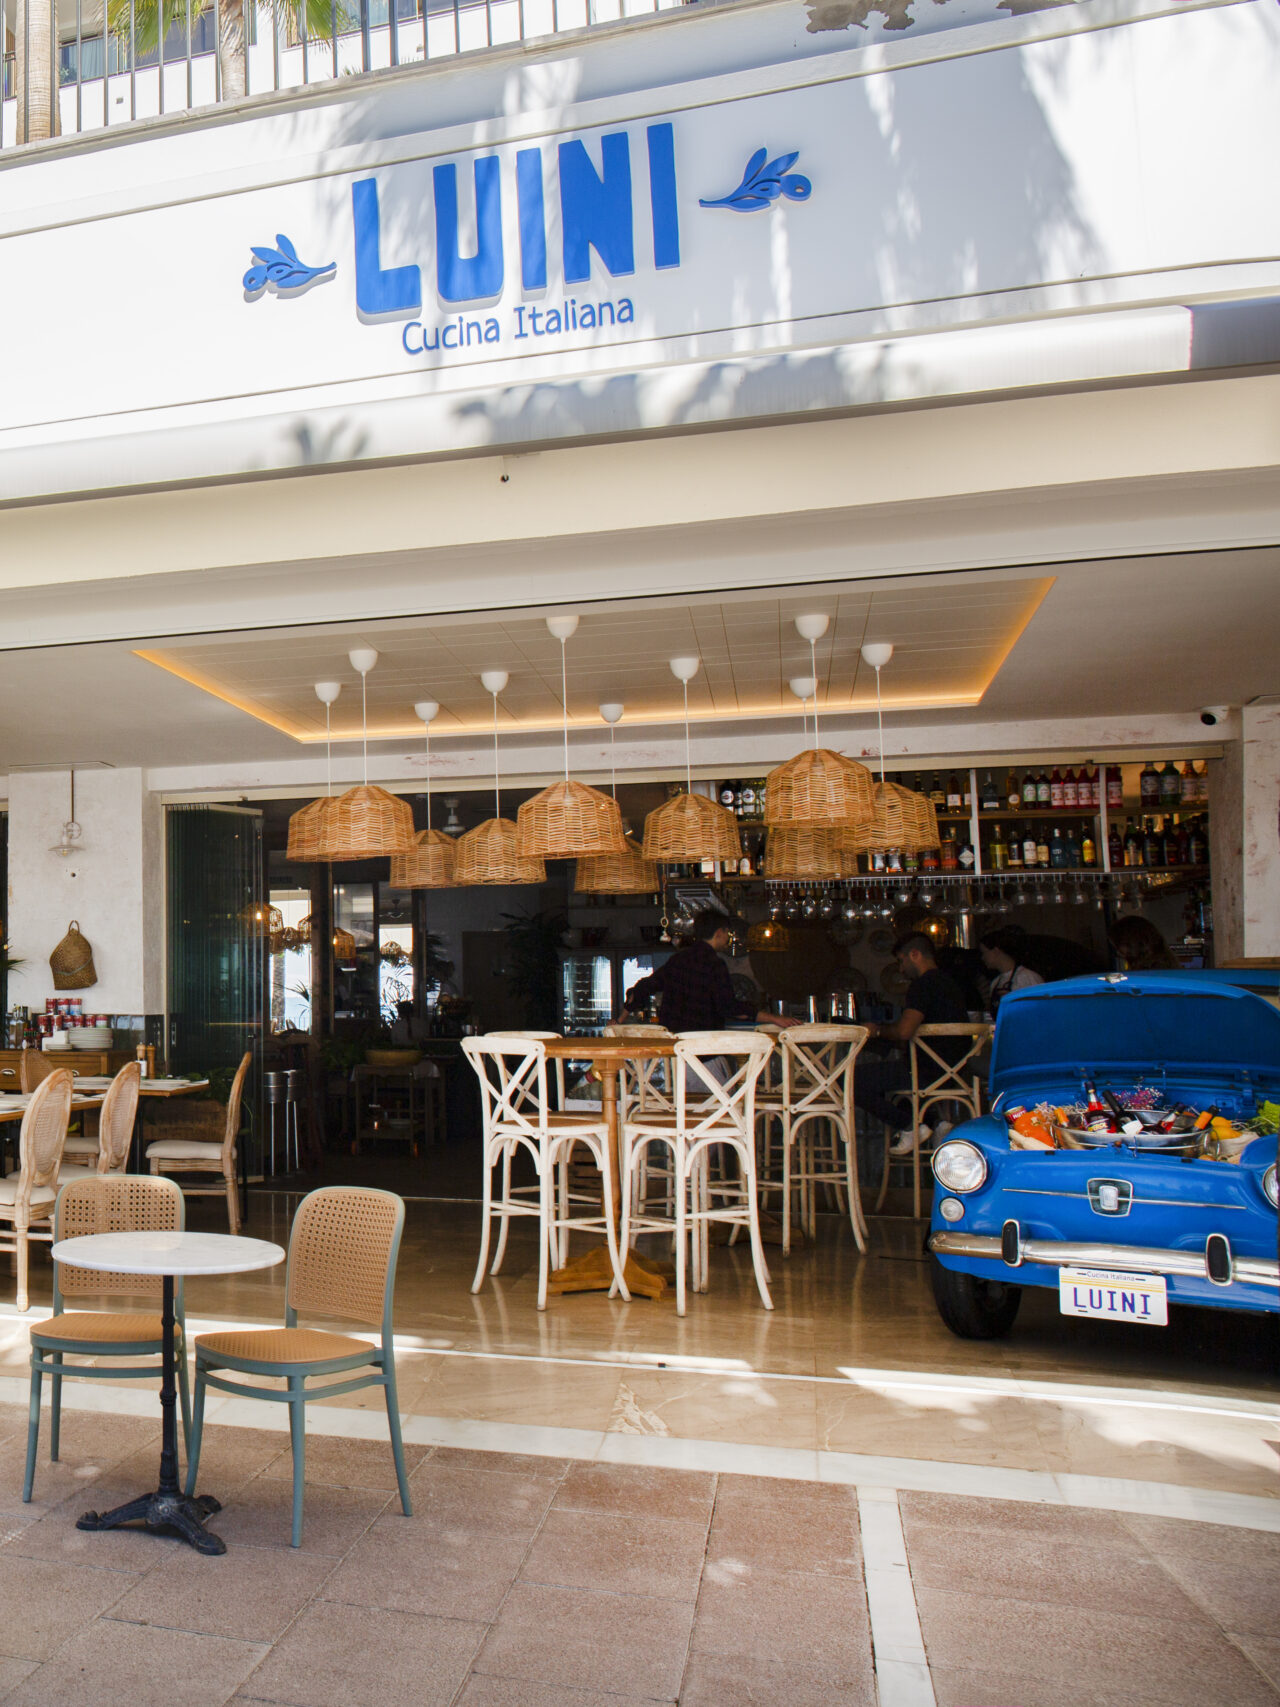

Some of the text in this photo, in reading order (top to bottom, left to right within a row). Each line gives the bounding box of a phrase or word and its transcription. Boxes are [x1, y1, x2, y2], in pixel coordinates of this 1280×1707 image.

[352, 122, 680, 315] LUINI
[402, 299, 634, 354] Cucina Italiana
[1086, 1271, 1109, 1280] Cucina
[1073, 1287, 1151, 1315] LUINI
